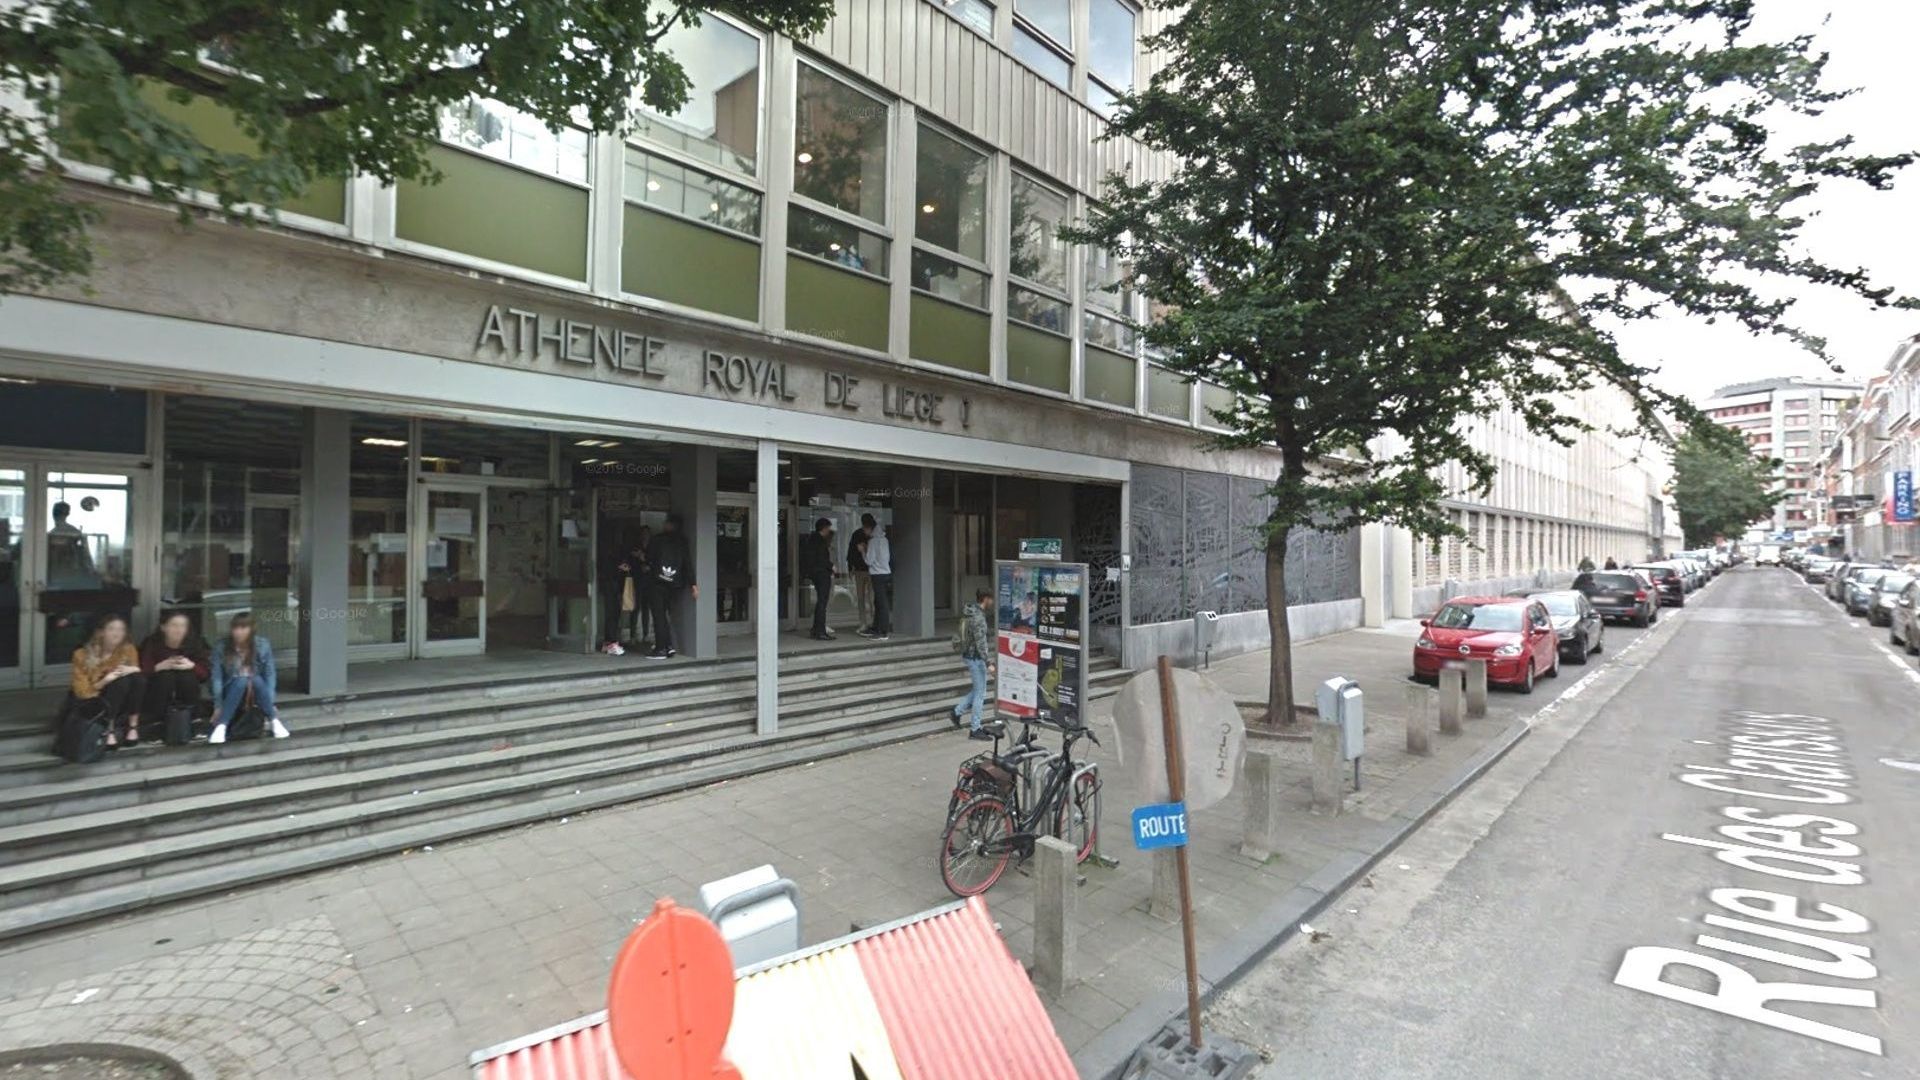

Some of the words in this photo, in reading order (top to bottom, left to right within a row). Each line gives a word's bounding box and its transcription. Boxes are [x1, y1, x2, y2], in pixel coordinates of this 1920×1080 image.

[478, 304, 668, 379] ATHENEE
[703, 350, 797, 402] ROYAL
[825, 370, 860, 412] DE
[882, 383, 944, 426] LIEGE
[1139, 813, 1186, 839] ROUTE
